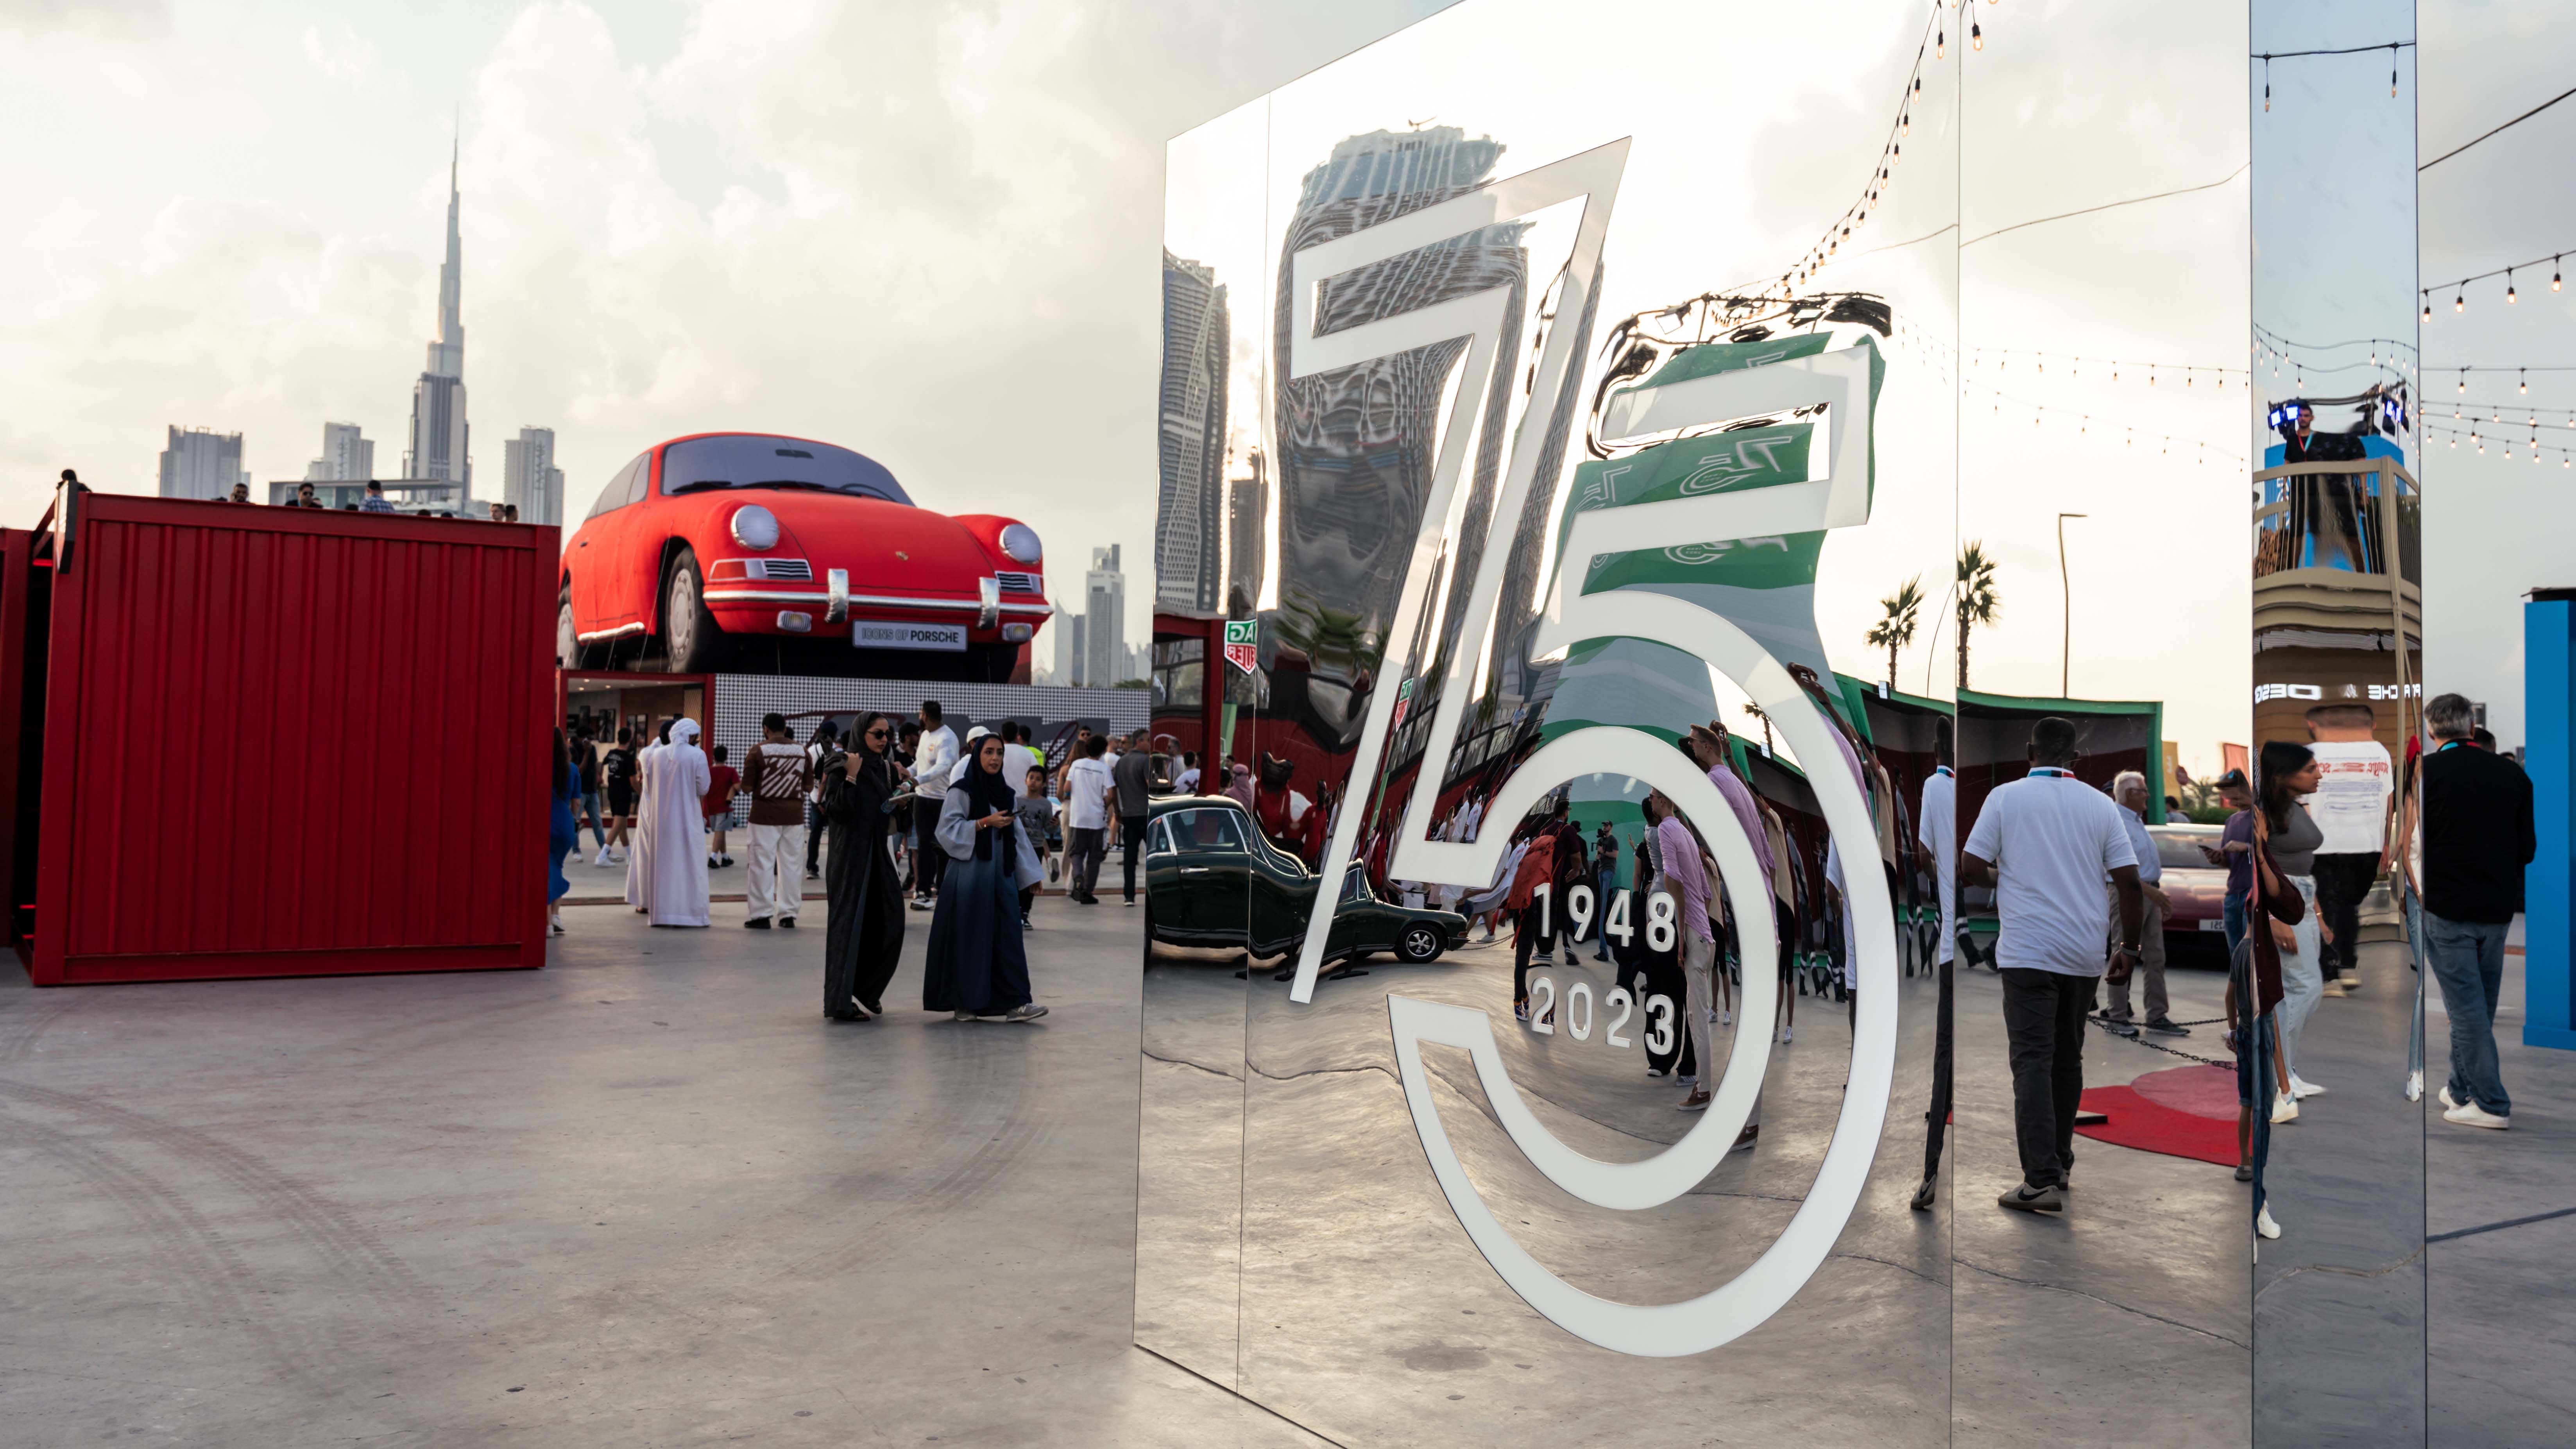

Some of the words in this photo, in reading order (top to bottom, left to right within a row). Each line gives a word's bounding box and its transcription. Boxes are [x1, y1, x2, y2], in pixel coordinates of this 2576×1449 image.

[862, 627, 894, 640] ICONS
[895, 628, 909, 641] OF
[910, 630, 959, 643] PORSCHE
[1292, 136, 1898, 1356] 75
[1533, 882, 1676, 952] 1948
[1531, 977, 1675, 1055] 2023
